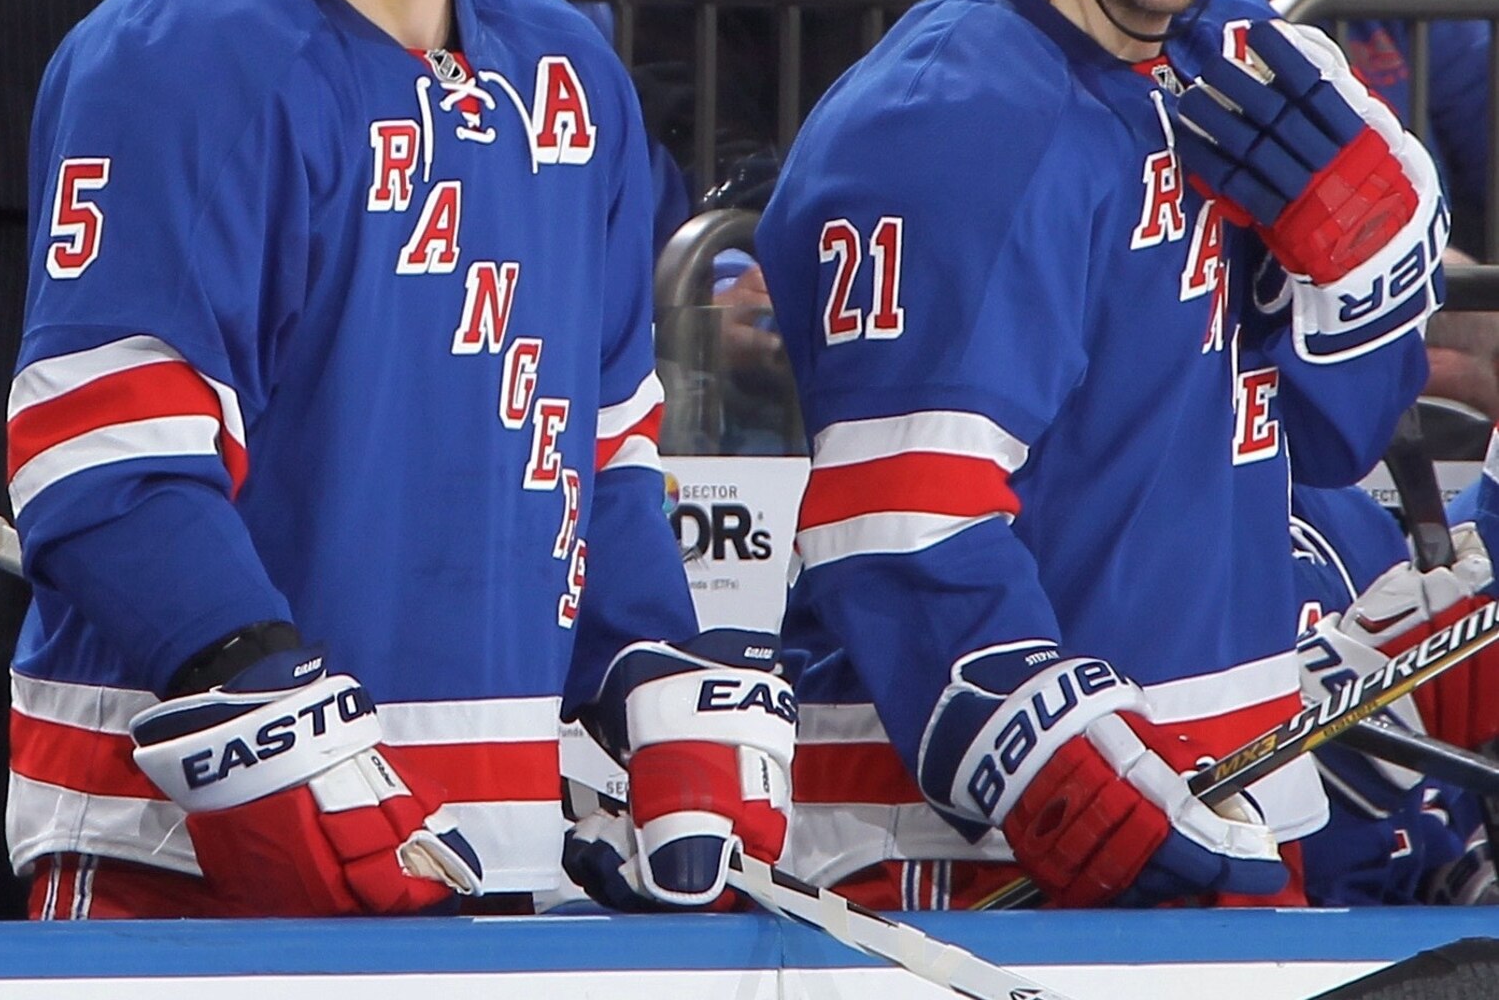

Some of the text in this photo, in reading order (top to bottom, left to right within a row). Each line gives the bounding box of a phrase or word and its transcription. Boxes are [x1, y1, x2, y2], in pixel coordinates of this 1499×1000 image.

[535, 56, 596, 164] A
[46, 157, 110, 280] 5
[820, 216, 904, 345] 21
[683, 486, 738, 499] SECTOR
[967, 661, 1128, 818] BAUE
[1215, 734, 1278, 782] MX3
